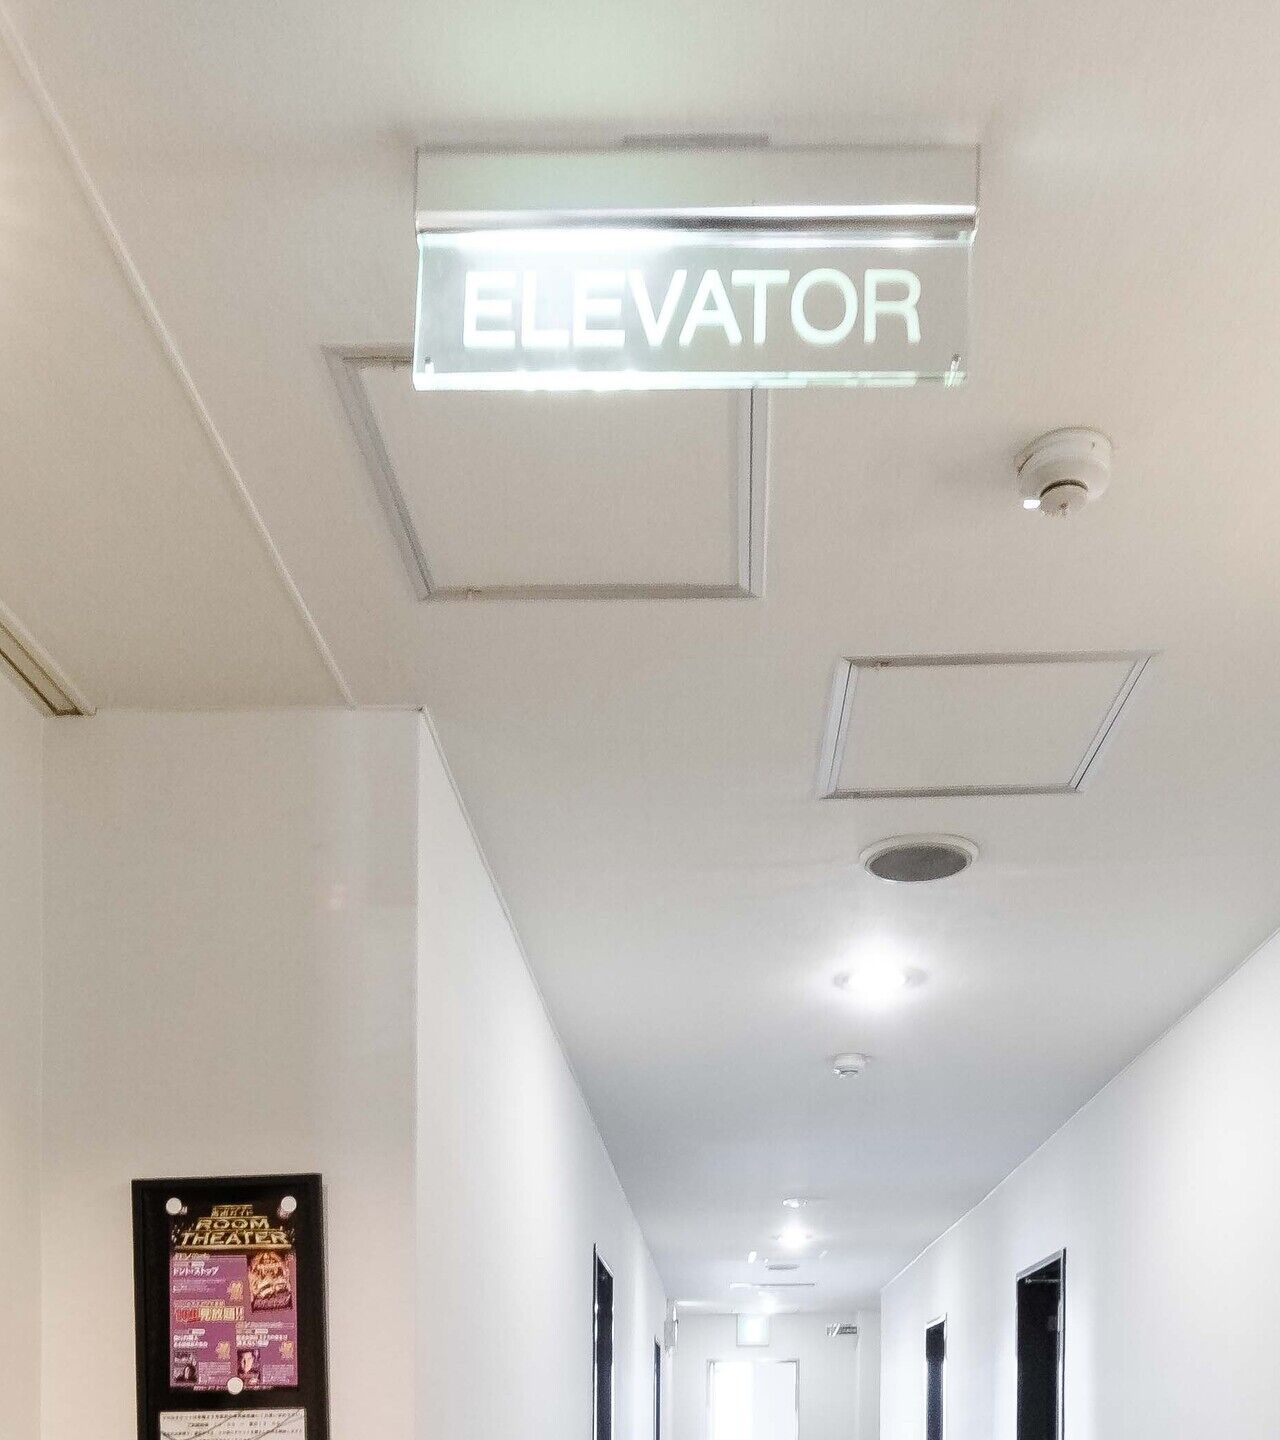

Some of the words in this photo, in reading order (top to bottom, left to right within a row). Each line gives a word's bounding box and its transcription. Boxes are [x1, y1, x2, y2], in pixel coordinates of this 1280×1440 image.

[461, 267, 922, 349] ELEVATOR
[195, 1219, 270, 1230] ROOM
[180, 1231, 290, 1246] THEATER
